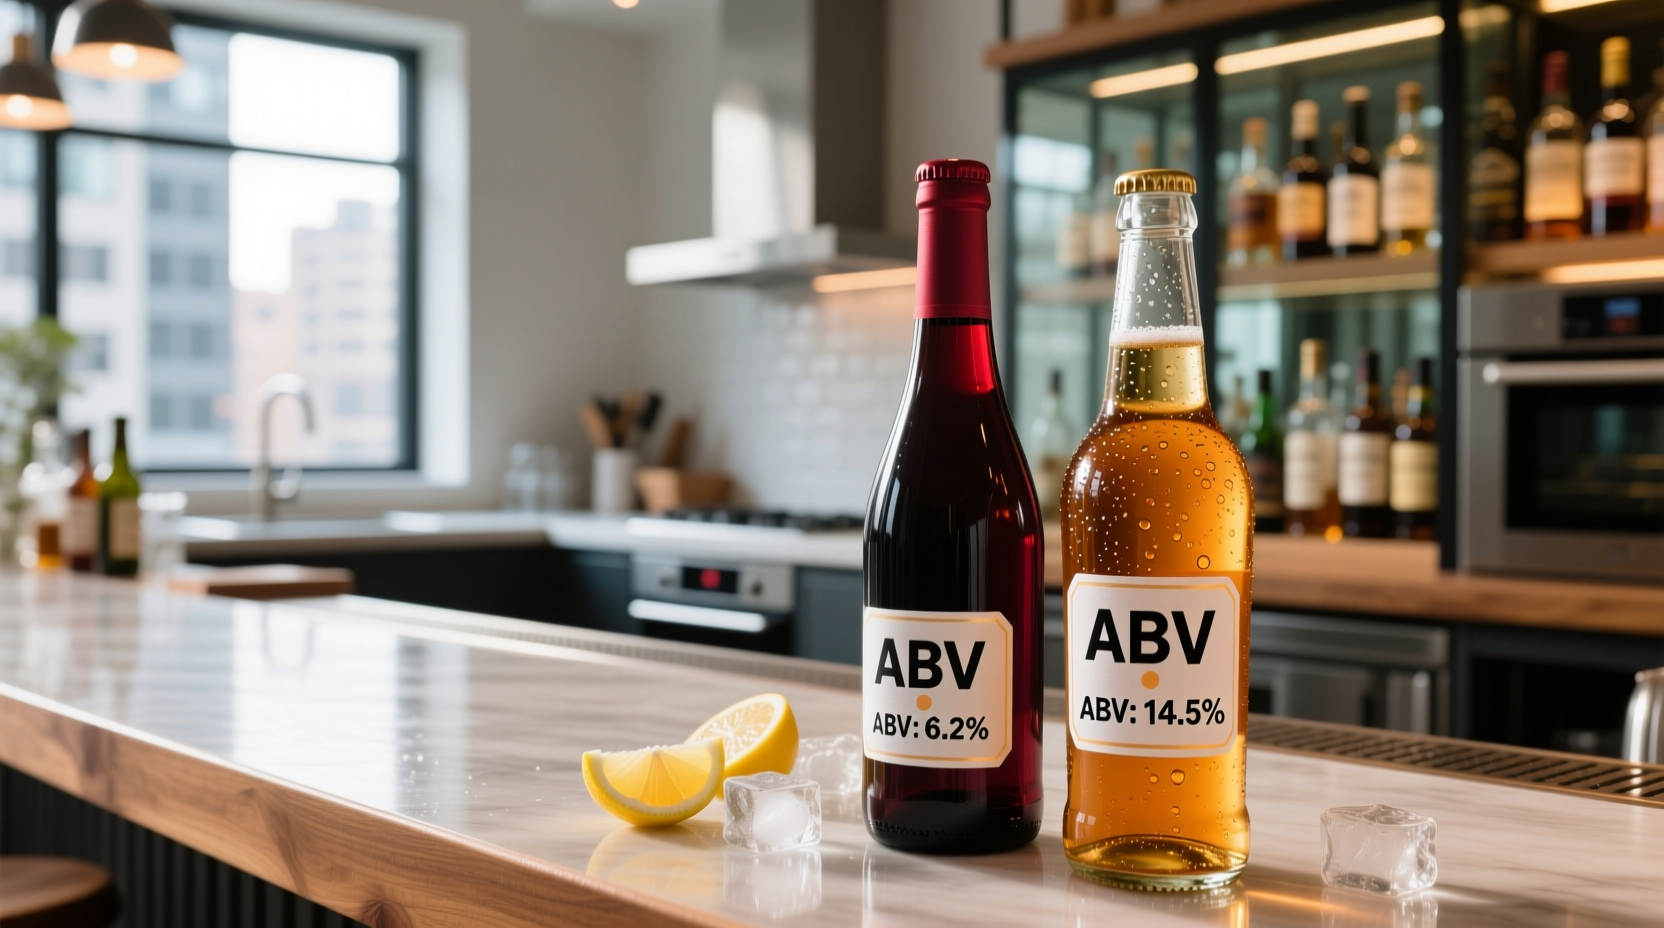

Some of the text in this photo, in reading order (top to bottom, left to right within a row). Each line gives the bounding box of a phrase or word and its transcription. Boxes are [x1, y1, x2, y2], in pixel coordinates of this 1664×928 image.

[1085, 608, 1216, 665] ABV
[874, 637, 986, 690] ABV
[872, 712, 989, 741] ABV: 6.2%
[1079, 695, 1225, 726] ABV: 14.5%
